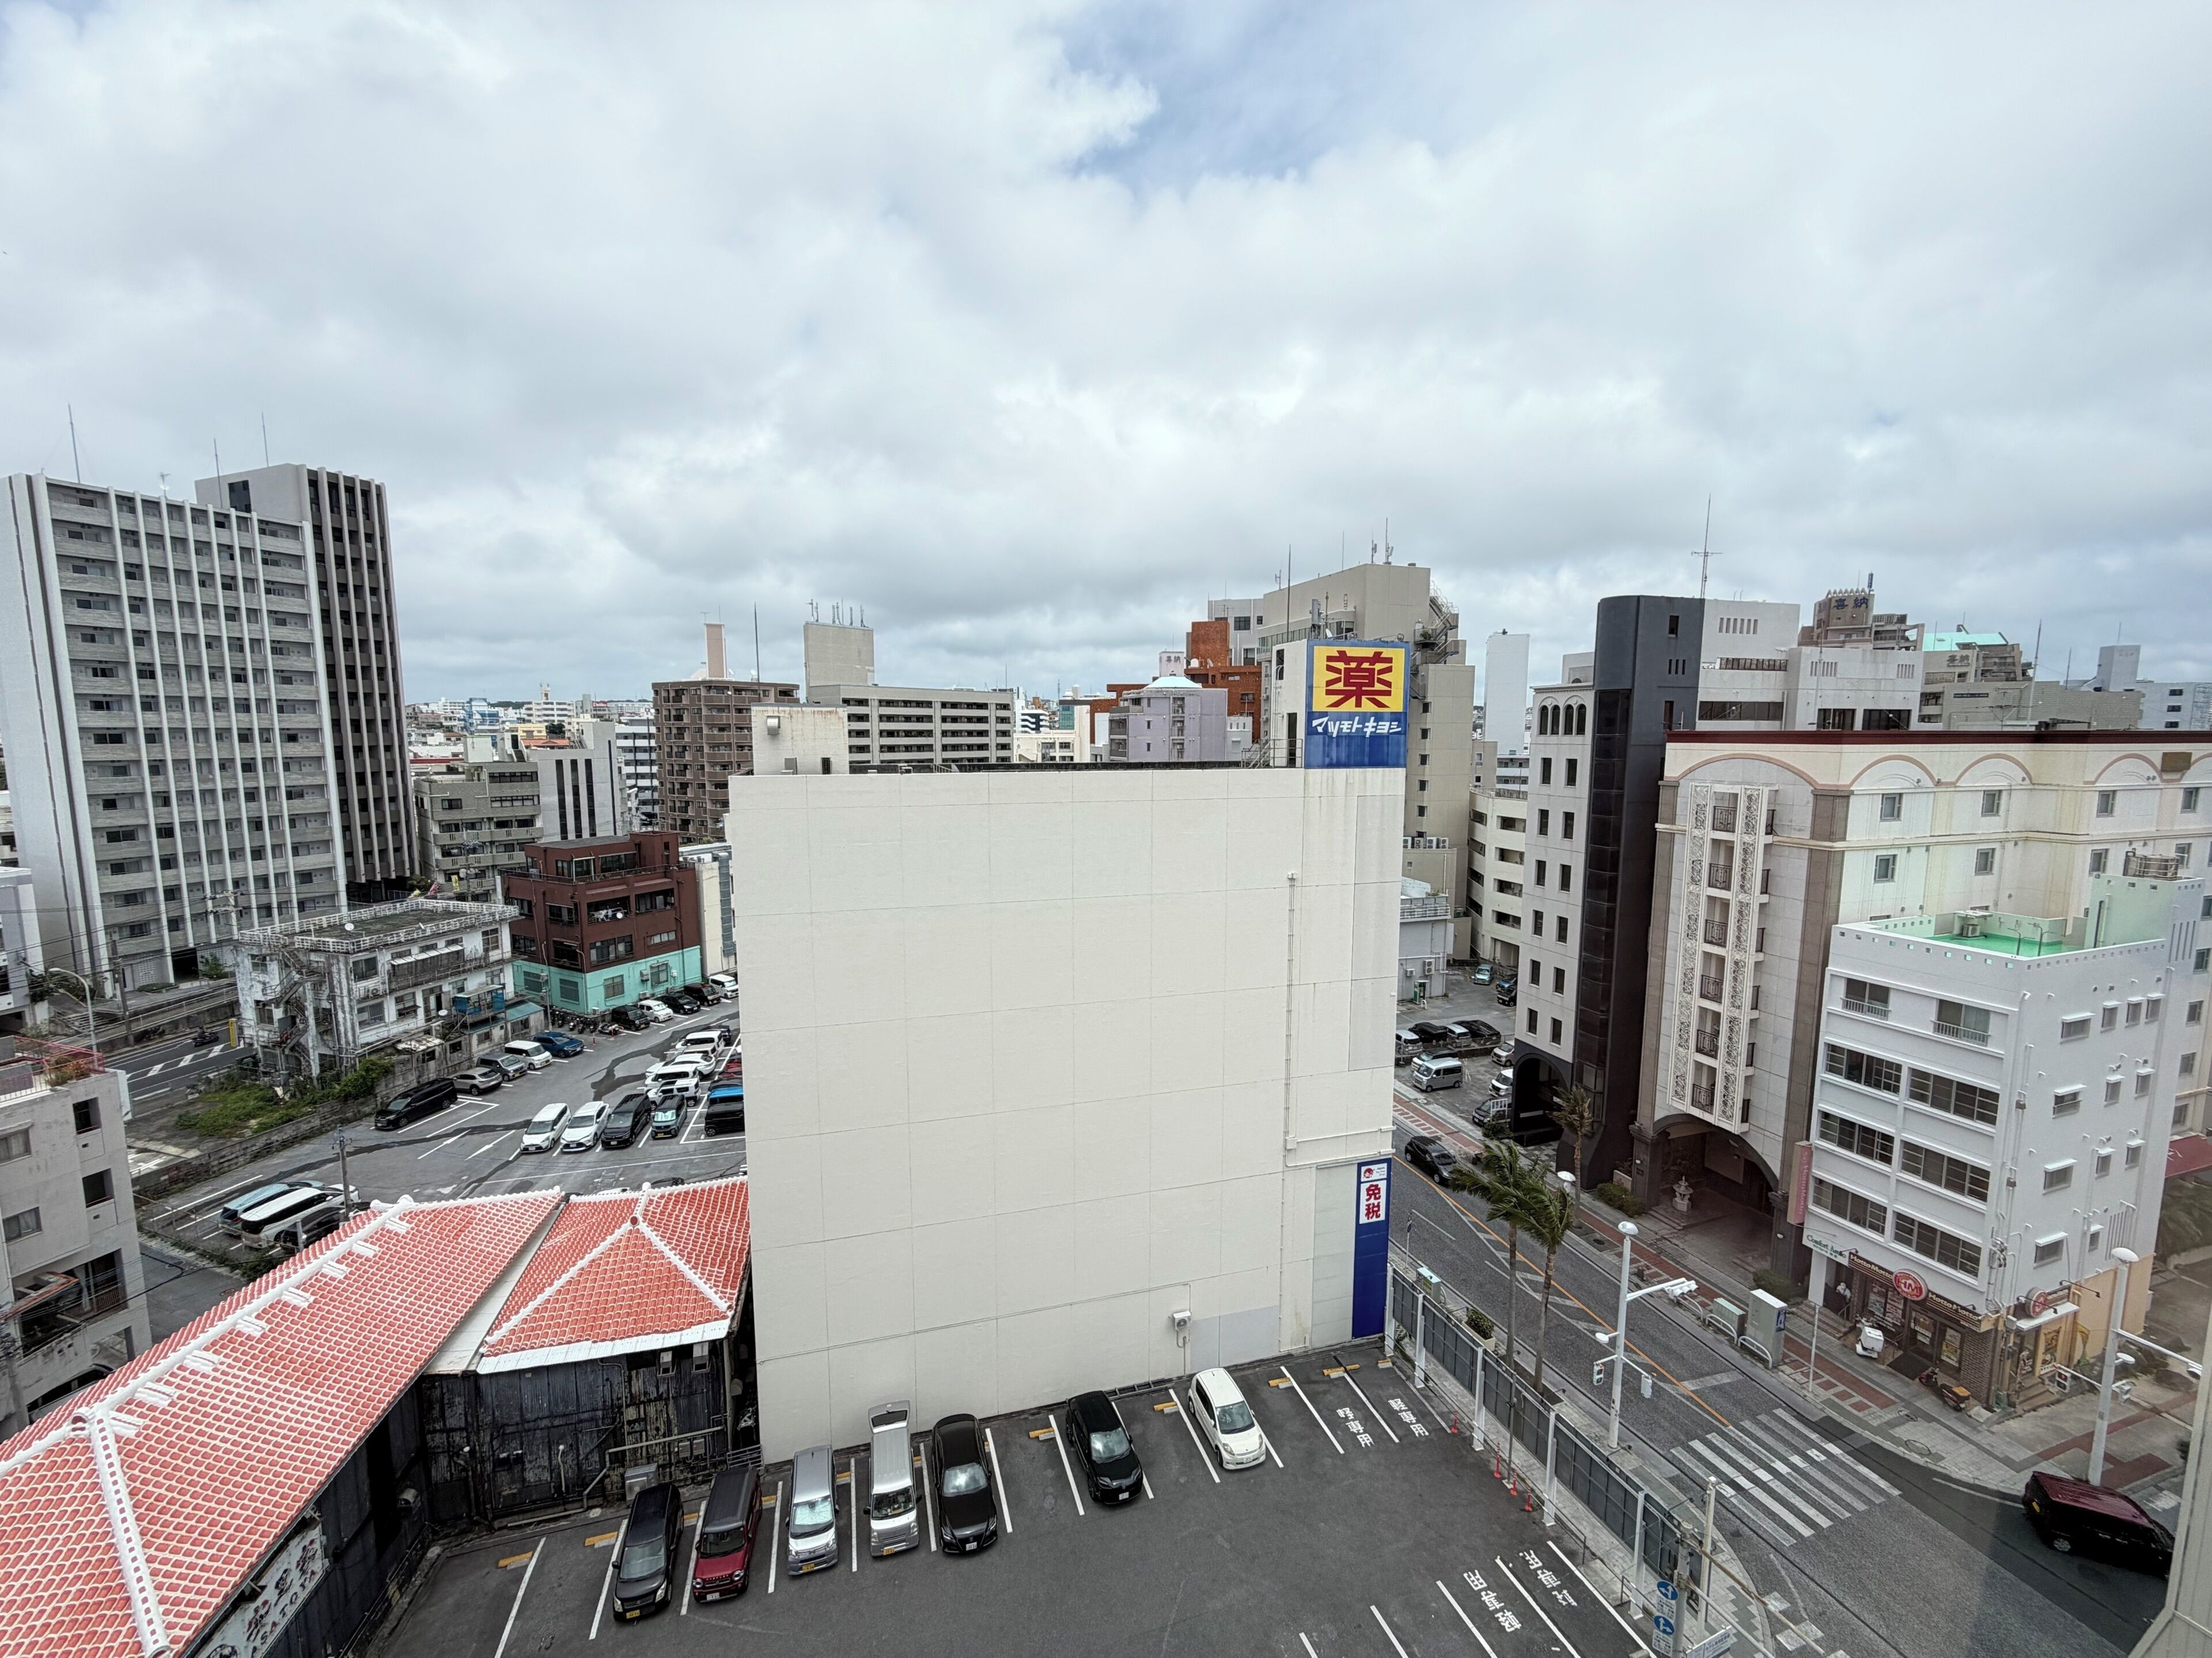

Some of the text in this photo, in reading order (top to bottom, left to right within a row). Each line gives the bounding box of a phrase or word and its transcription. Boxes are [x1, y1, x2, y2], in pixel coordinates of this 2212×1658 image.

[1325, 650, 1393, 708] 薬
[1312, 716, 1402, 738] マツモトキヨシ
[1364, 1183, 1381, 1220] 免税
[1850, 1254, 1893, 1279] HottoMotto
